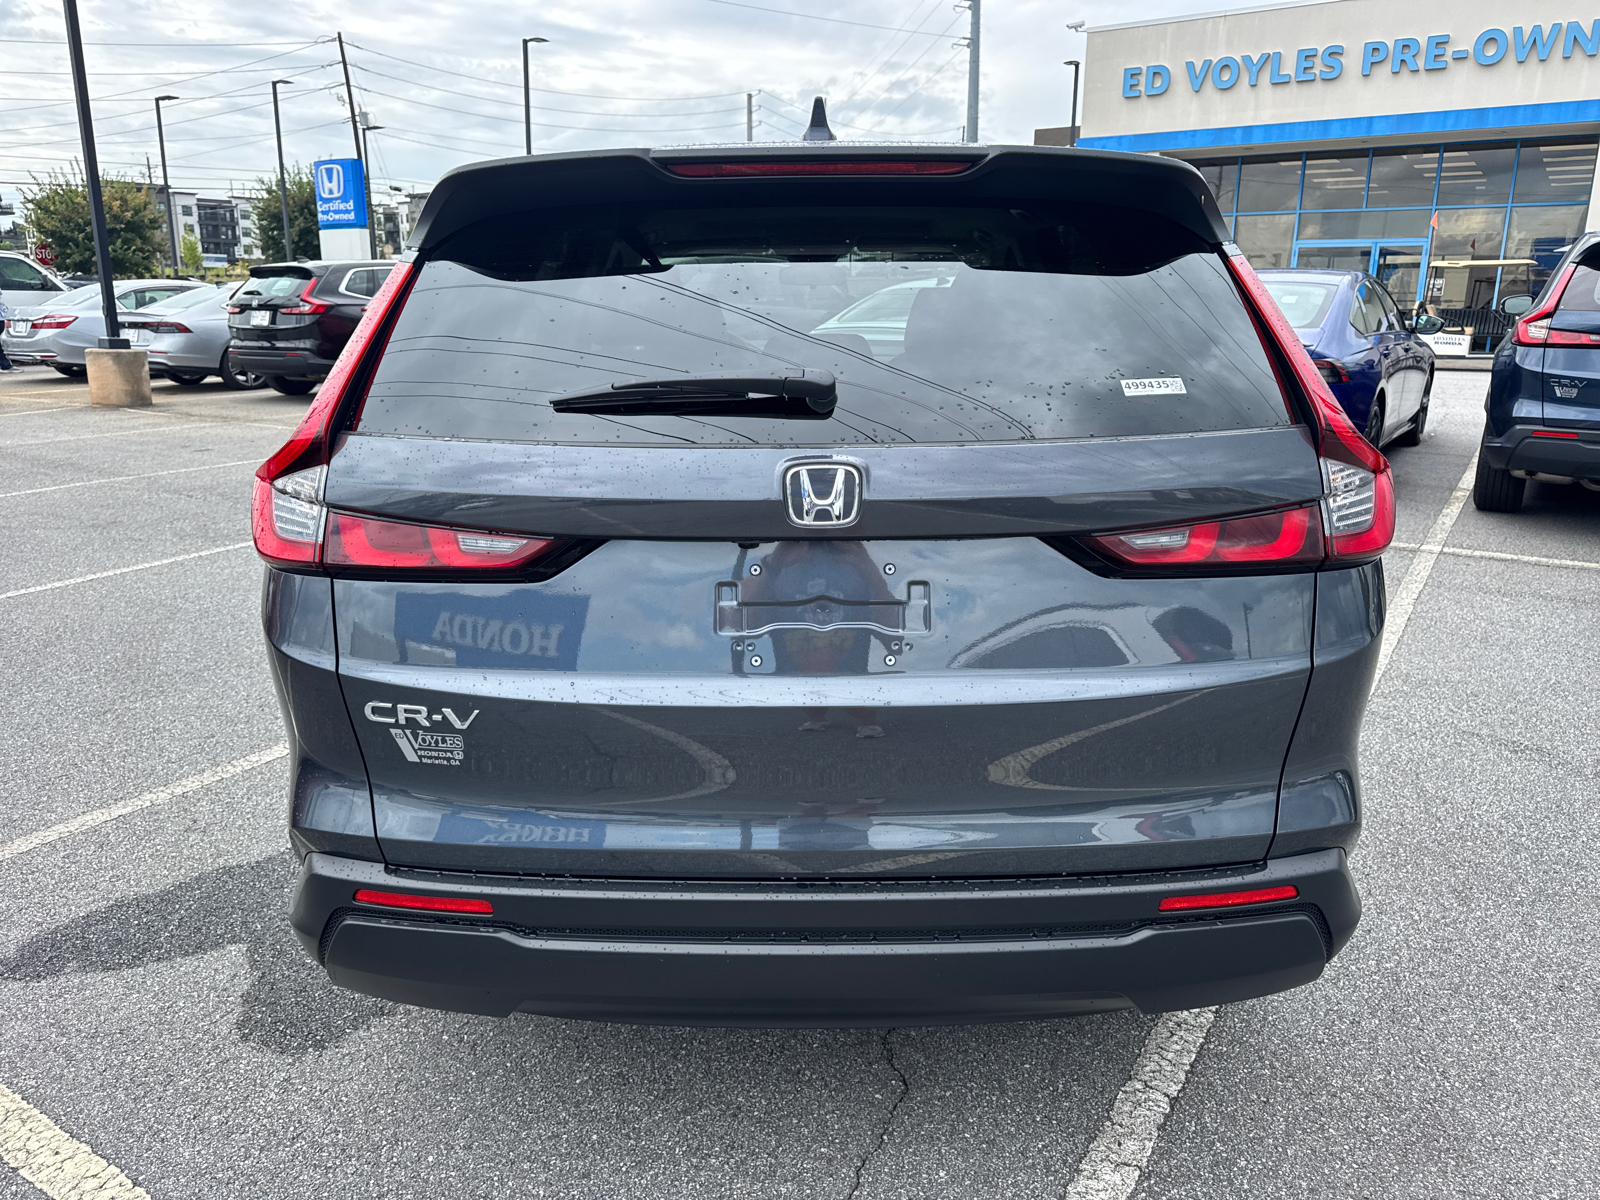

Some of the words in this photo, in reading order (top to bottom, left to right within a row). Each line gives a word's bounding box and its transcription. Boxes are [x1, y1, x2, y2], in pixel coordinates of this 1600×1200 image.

[1121, 64, 1172, 98] ED
[1184, 44, 1345, 92] VOYLES
[317, 200, 354, 211] Certified
[36, 249, 55, 259] STO
[1124, 380, 1170, 390] 499435
[364, 700, 480, 730] CR-V
[394, 732, 405, 740] ED
[417, 750, 453, 758] HONDA
[421, 757, 449, 765] Marietta,
[450, 758, 461, 766] GA
